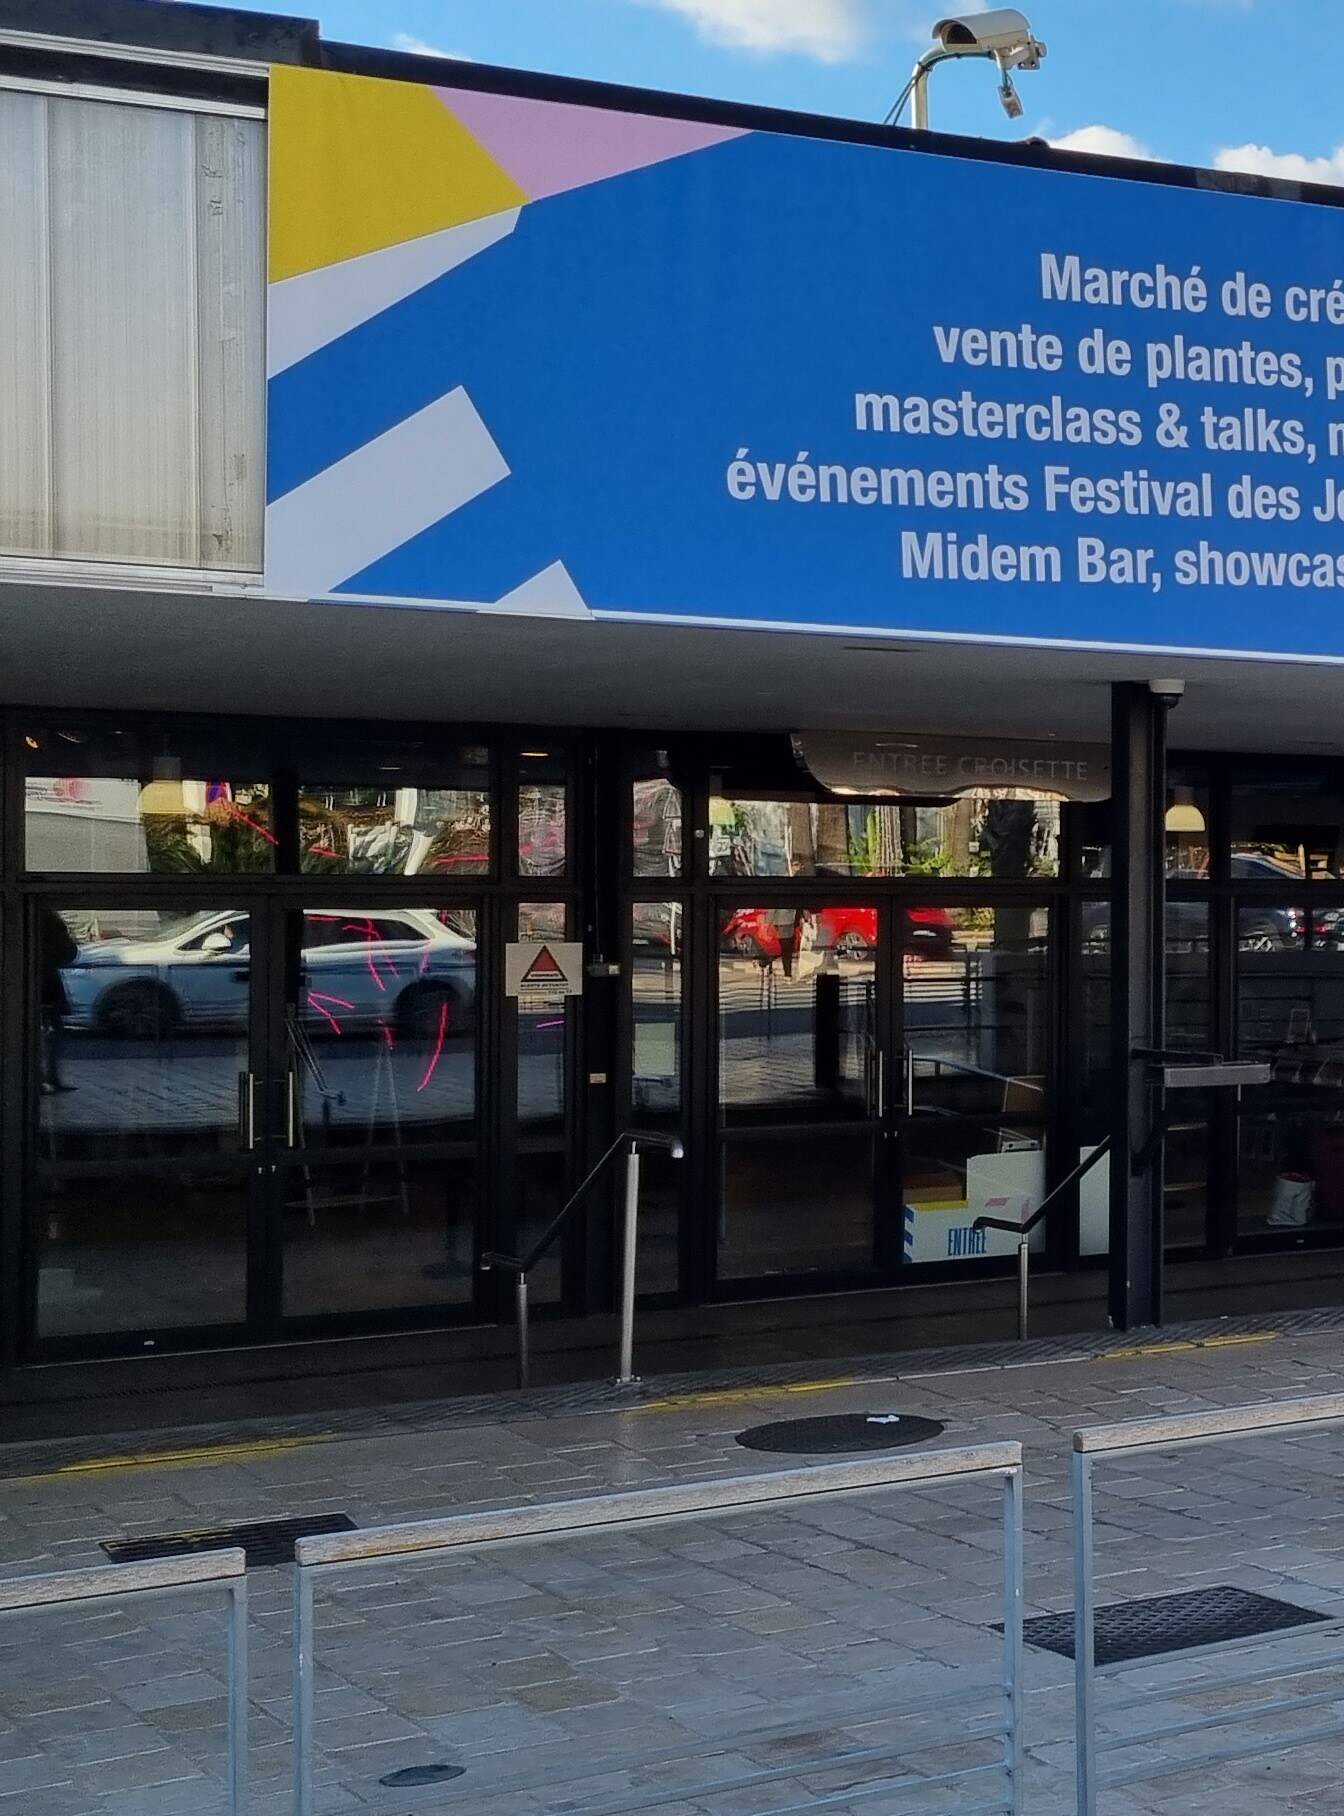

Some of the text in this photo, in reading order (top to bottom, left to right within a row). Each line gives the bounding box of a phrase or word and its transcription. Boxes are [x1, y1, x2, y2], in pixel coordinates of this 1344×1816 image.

[1040, 253, 1208, 313] Marché
[1221, 271, 1272, 318] de
[932, 323, 1063, 371] vente
[1078, 329, 1132, 376] de
[1146, 334, 1314, 398] plantes,
[855, 390, 1143, 447] masterclass
[1155, 402, 1190, 448] &
[1200, 406, 1316, 464] talks,
[726, 447, 1029, 511] événements
[1044, 465, 1213, 517] Festival
[1227, 475, 1301, 522] des
[901, 530, 1062, 582] Midem
[1077, 536, 1162, 593] Bar,
[957, 756, 1089, 780] CROISETTE
